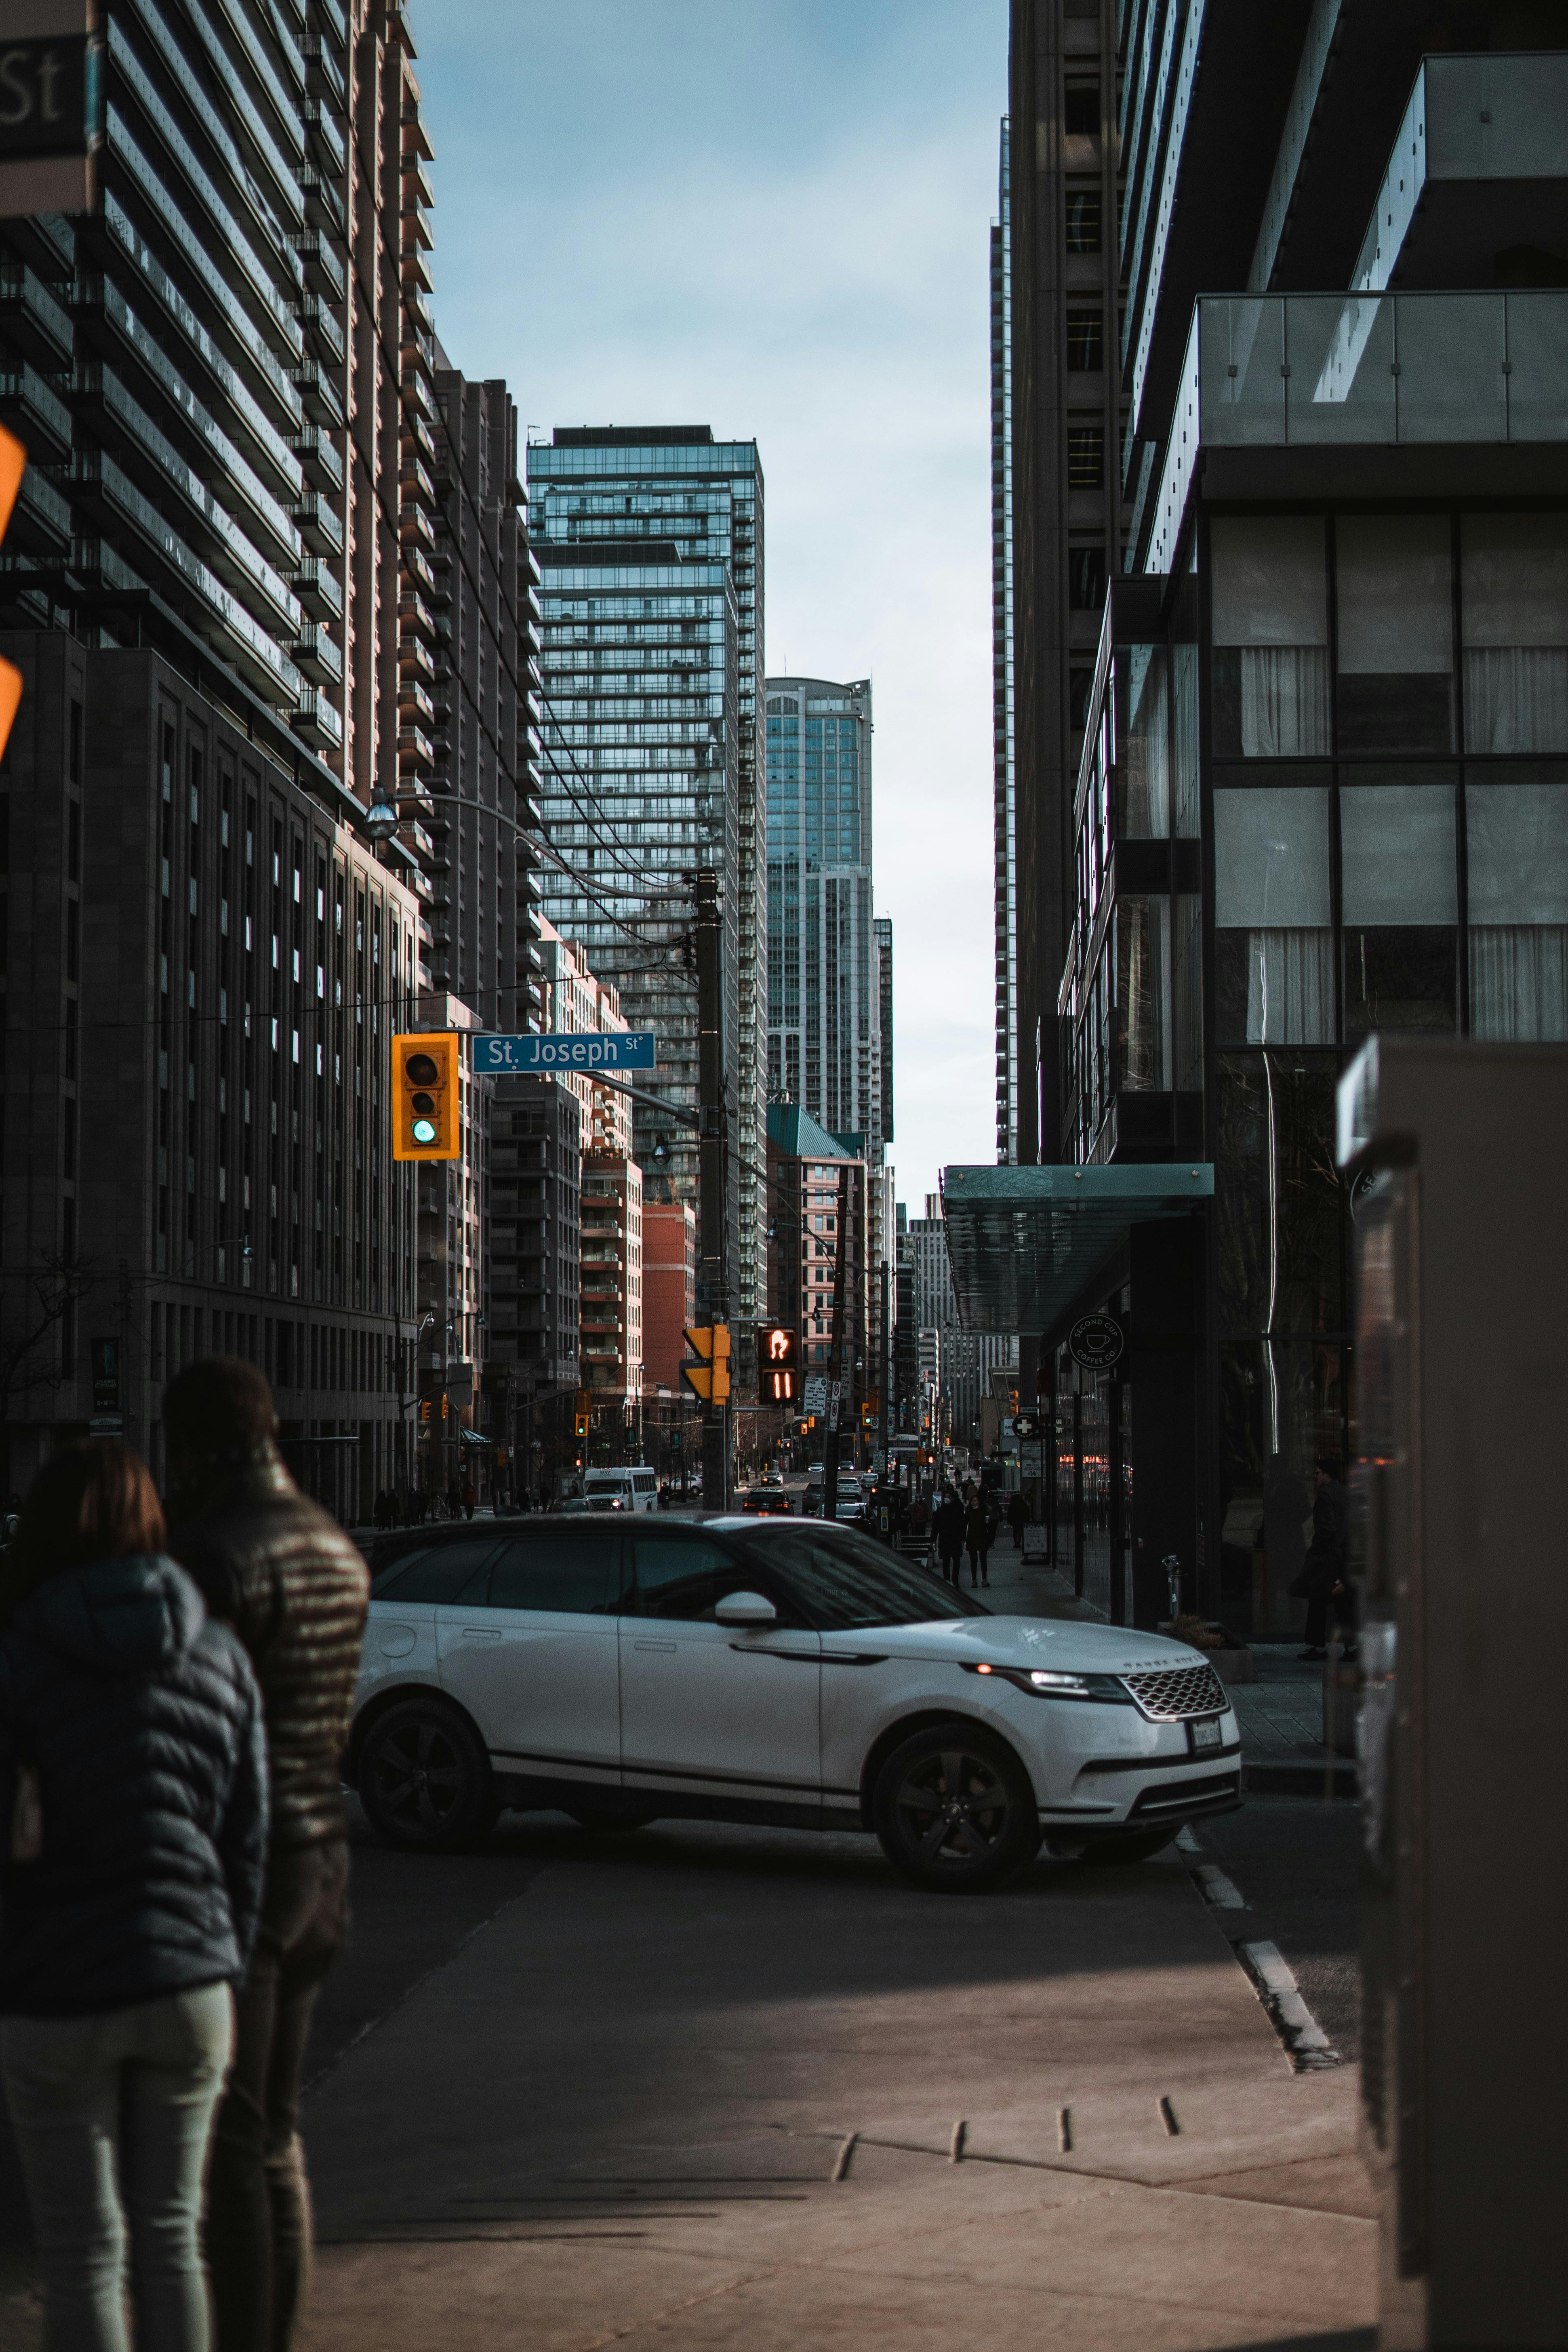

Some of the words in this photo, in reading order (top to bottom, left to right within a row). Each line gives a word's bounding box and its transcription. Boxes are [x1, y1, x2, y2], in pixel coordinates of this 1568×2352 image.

[0, 50, 63, 124] St
[488, 1040, 519, 1064] St.
[529, 1037, 618, 1067] Joseph
[625, 1037, 638, 1050] St
[1074, 1319, 1103, 1338] SECOND
[1105, 1322, 1118, 1336] CUP
[1077, 1349, 1103, 1364] COFFEE
